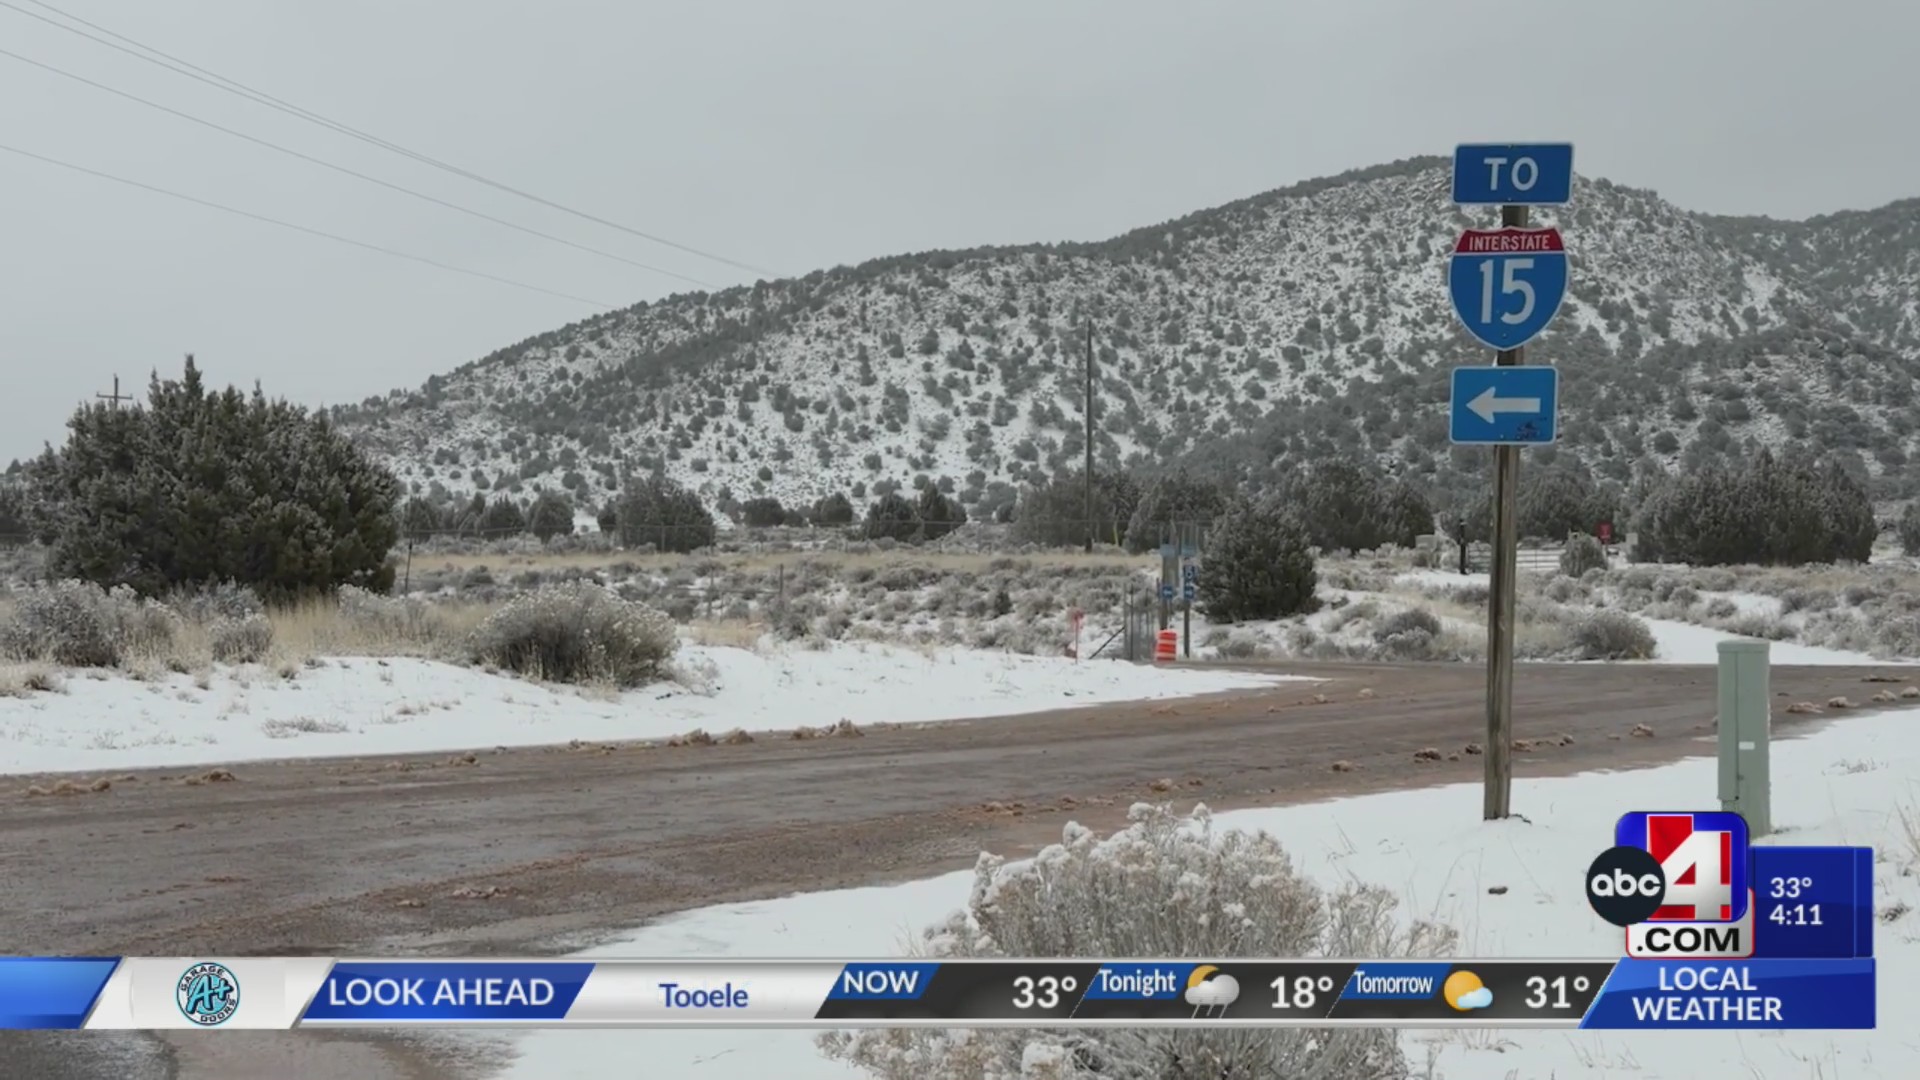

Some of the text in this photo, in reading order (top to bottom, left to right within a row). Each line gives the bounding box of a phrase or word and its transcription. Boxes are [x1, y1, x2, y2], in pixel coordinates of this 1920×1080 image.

[1483, 156, 1539, 192] TO
[1468, 233, 1551, 252] INTERSTATE
[1479, 258, 1536, 325] 15
